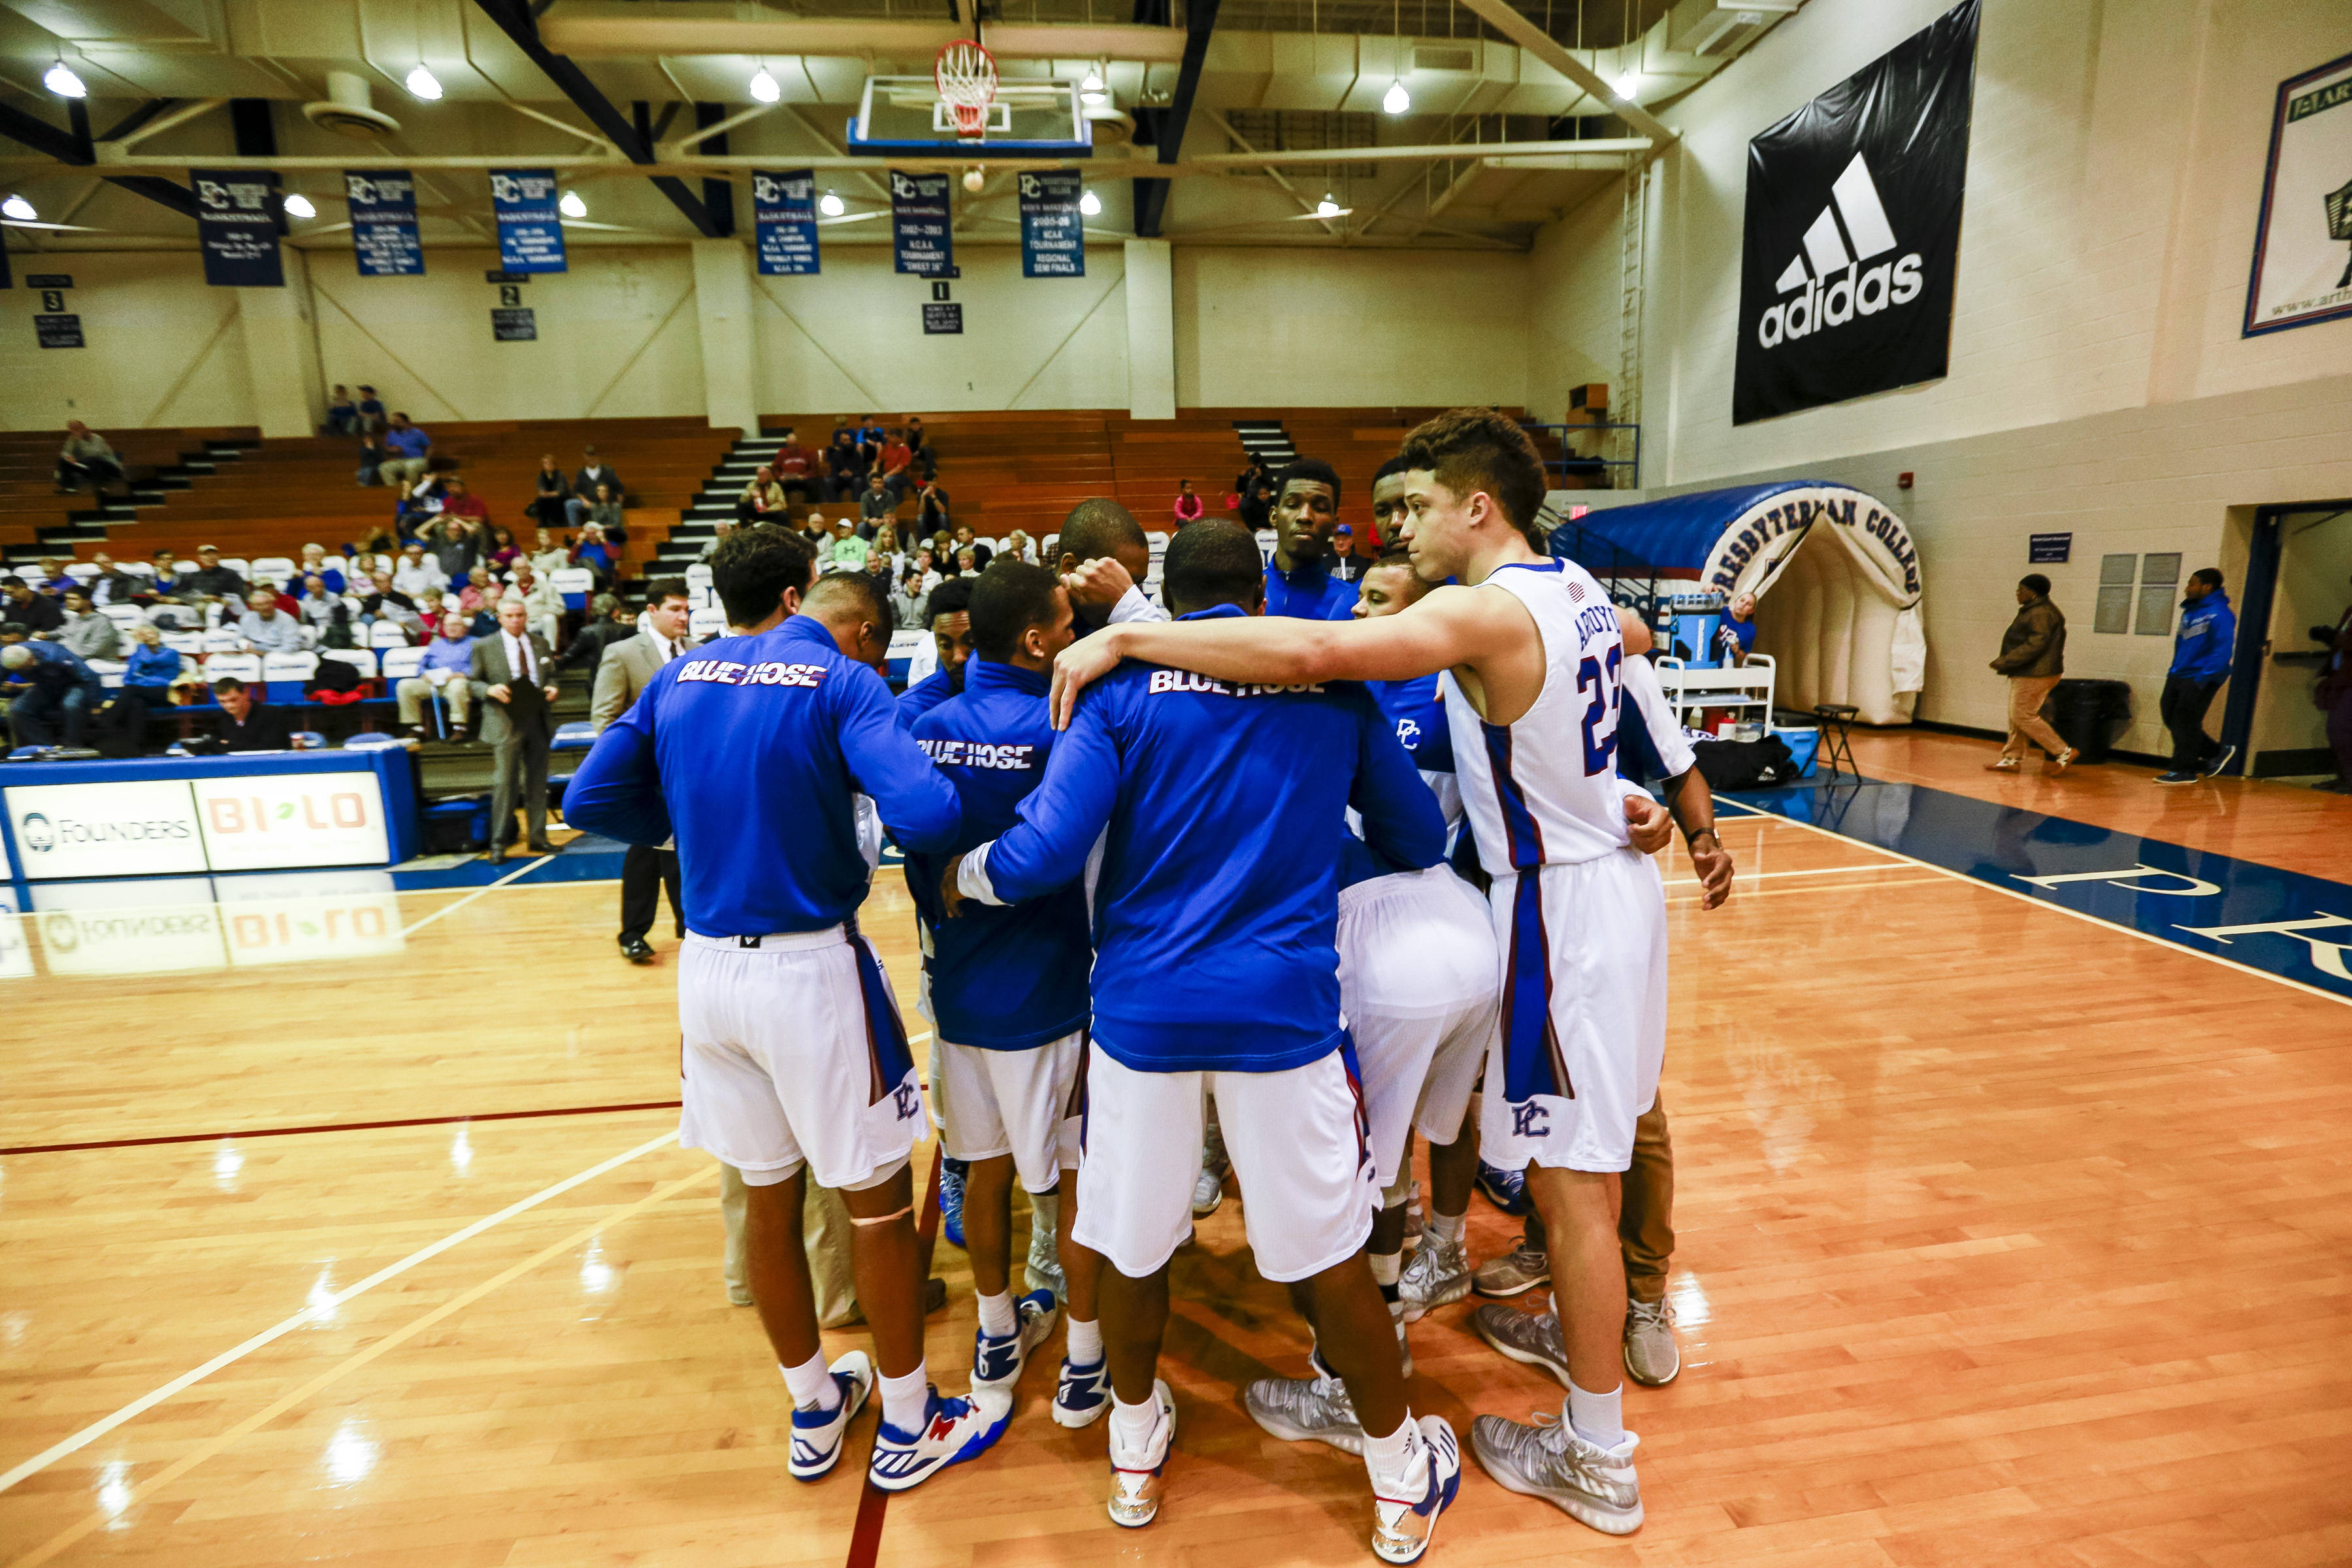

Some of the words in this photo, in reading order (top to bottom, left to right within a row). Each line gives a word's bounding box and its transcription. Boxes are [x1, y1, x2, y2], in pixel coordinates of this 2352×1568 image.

[1021, 174, 1041, 199] PC
[900, 250, 945, 260] TOURNAMENT
[1030, 239, 1077, 251] TOURNAMENT
[1036, 253, 1071, 263] REGIONAL
[1758, 252, 1923, 350] adidas
[677, 659, 747, 684] BLUE
[740, 661, 828, 689] HOSE
[1396, 718, 1421, 750] PC
[1511, 1100, 1551, 1137] PC
